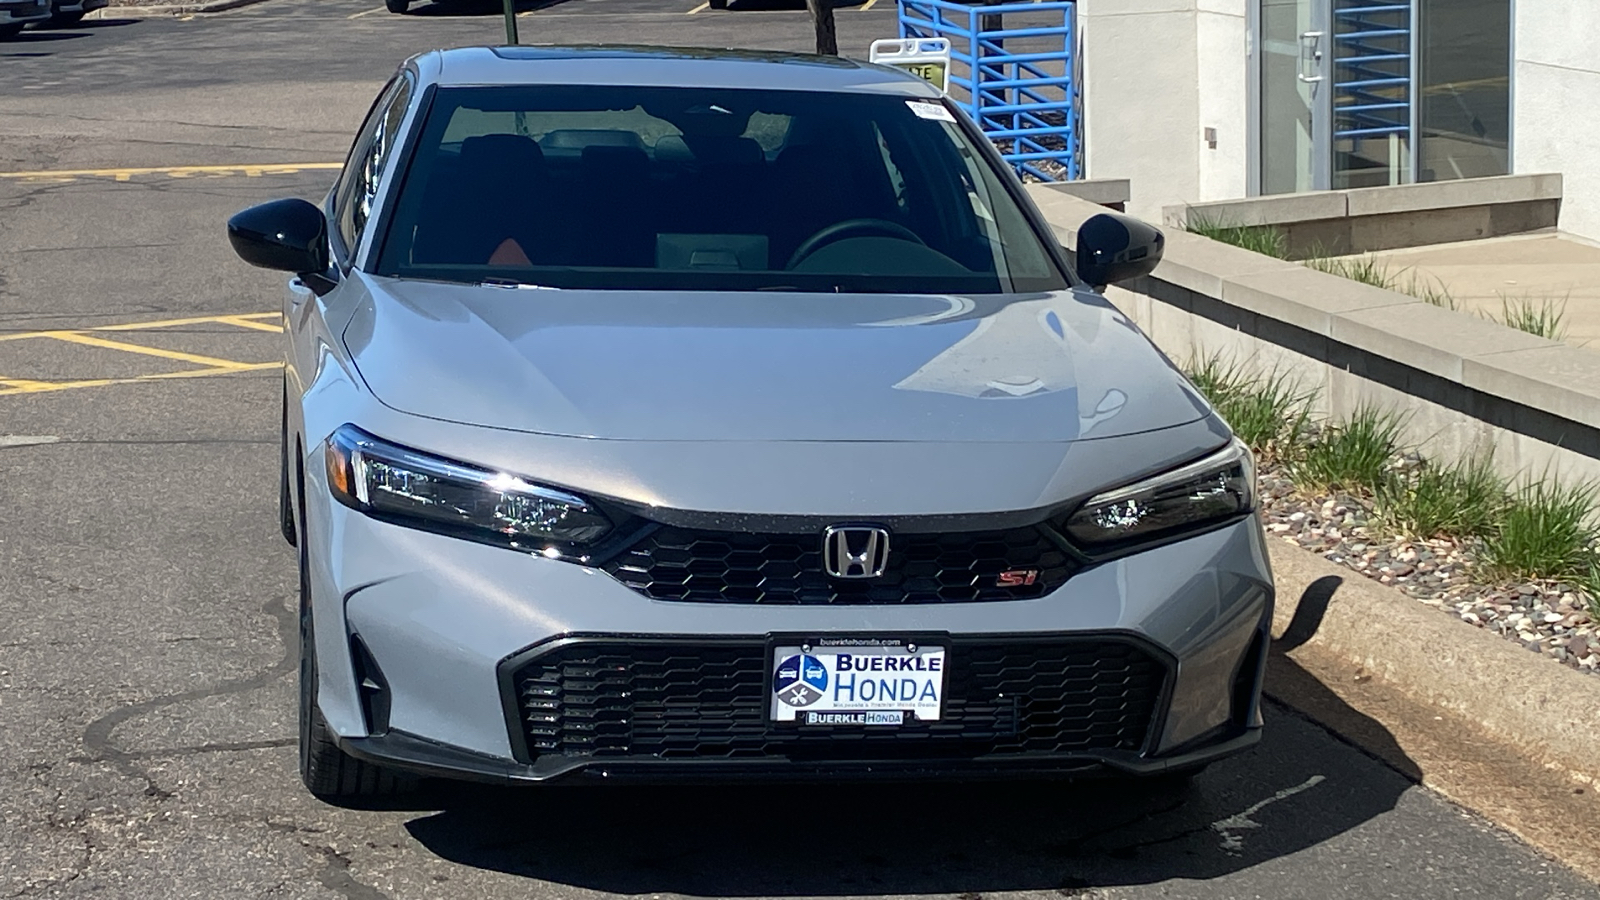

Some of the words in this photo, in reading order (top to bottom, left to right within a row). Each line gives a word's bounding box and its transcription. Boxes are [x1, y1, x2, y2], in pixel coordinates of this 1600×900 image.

[819, 638, 901, 646] buerklehonda.com
[835, 654, 942, 672] BUERKLE
[833, 673, 938, 702] HONDA
[808, 712, 865, 724] BUERKLE
[867, 712, 901, 723] HONDA
